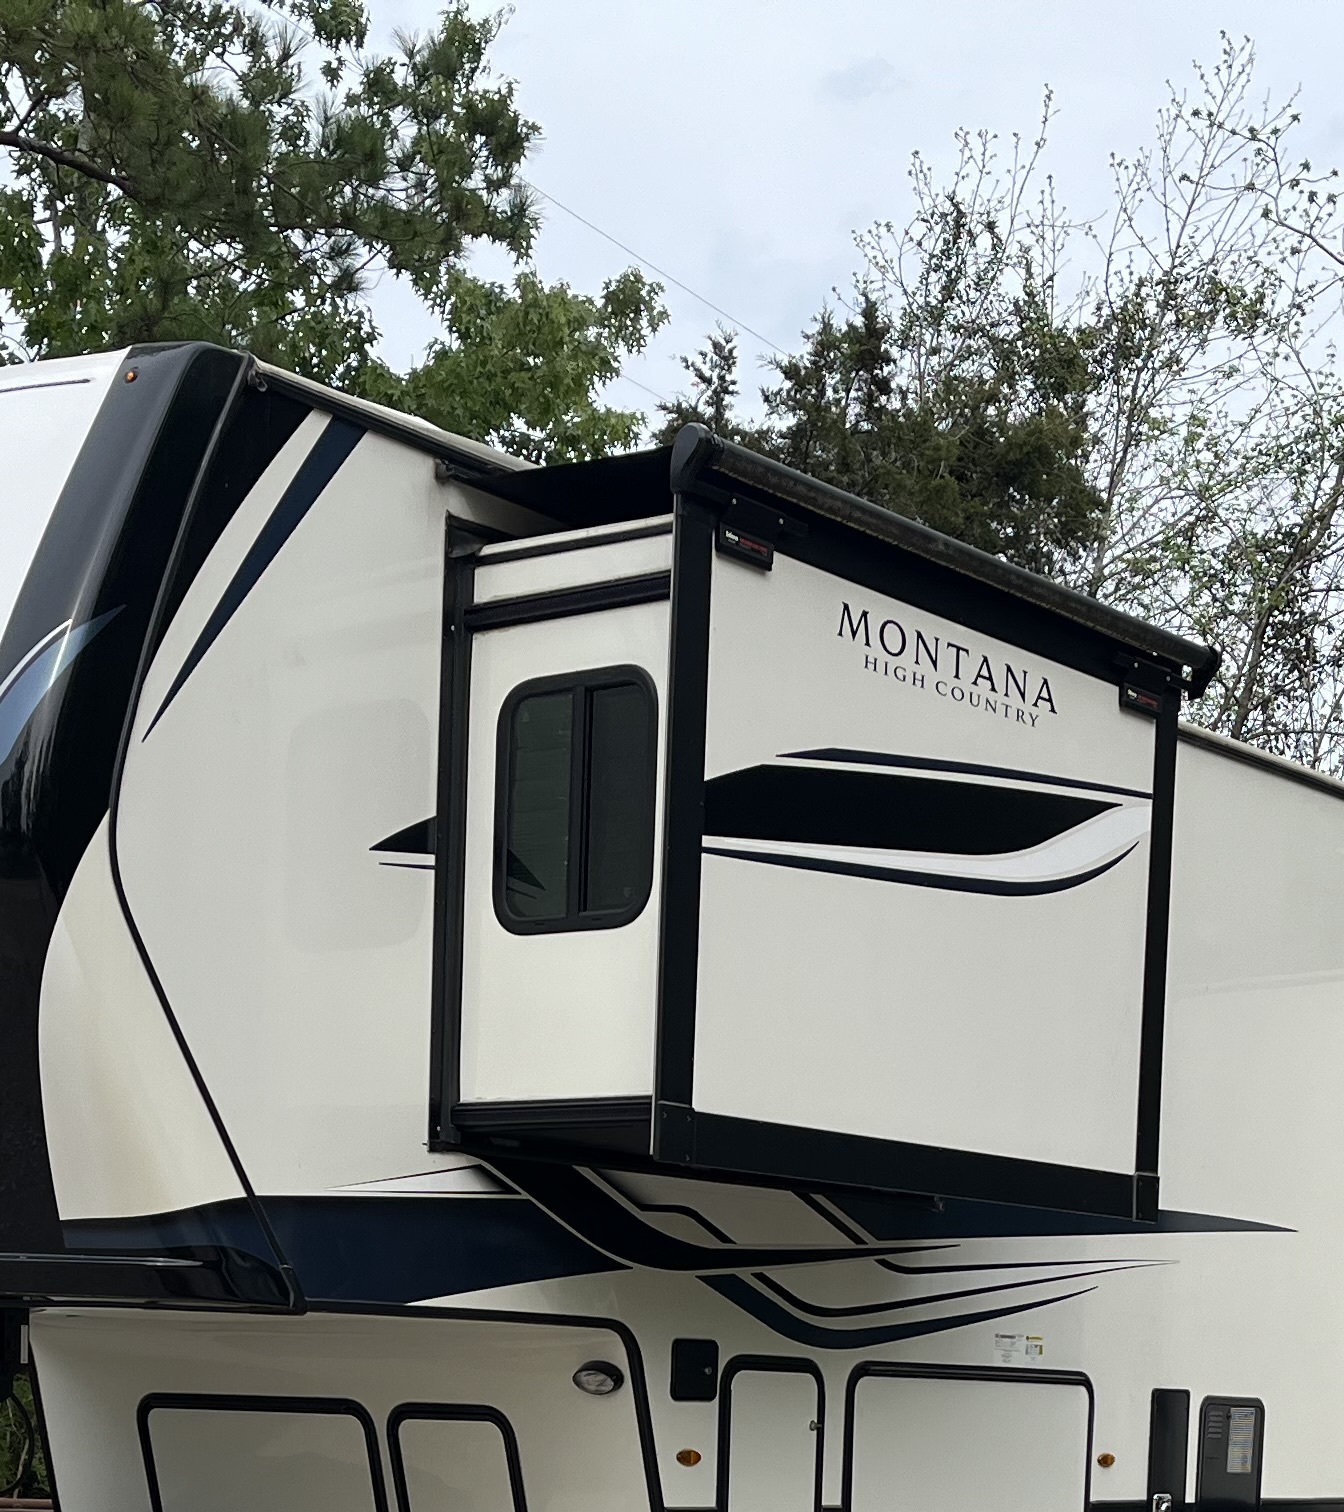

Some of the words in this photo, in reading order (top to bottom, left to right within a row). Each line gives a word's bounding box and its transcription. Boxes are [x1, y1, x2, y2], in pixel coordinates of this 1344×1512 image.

[837, 601, 1058, 714] MONTANA
[864, 653, 926, 690] HIGH
[934, 681, 1040, 728] COUNTRY
